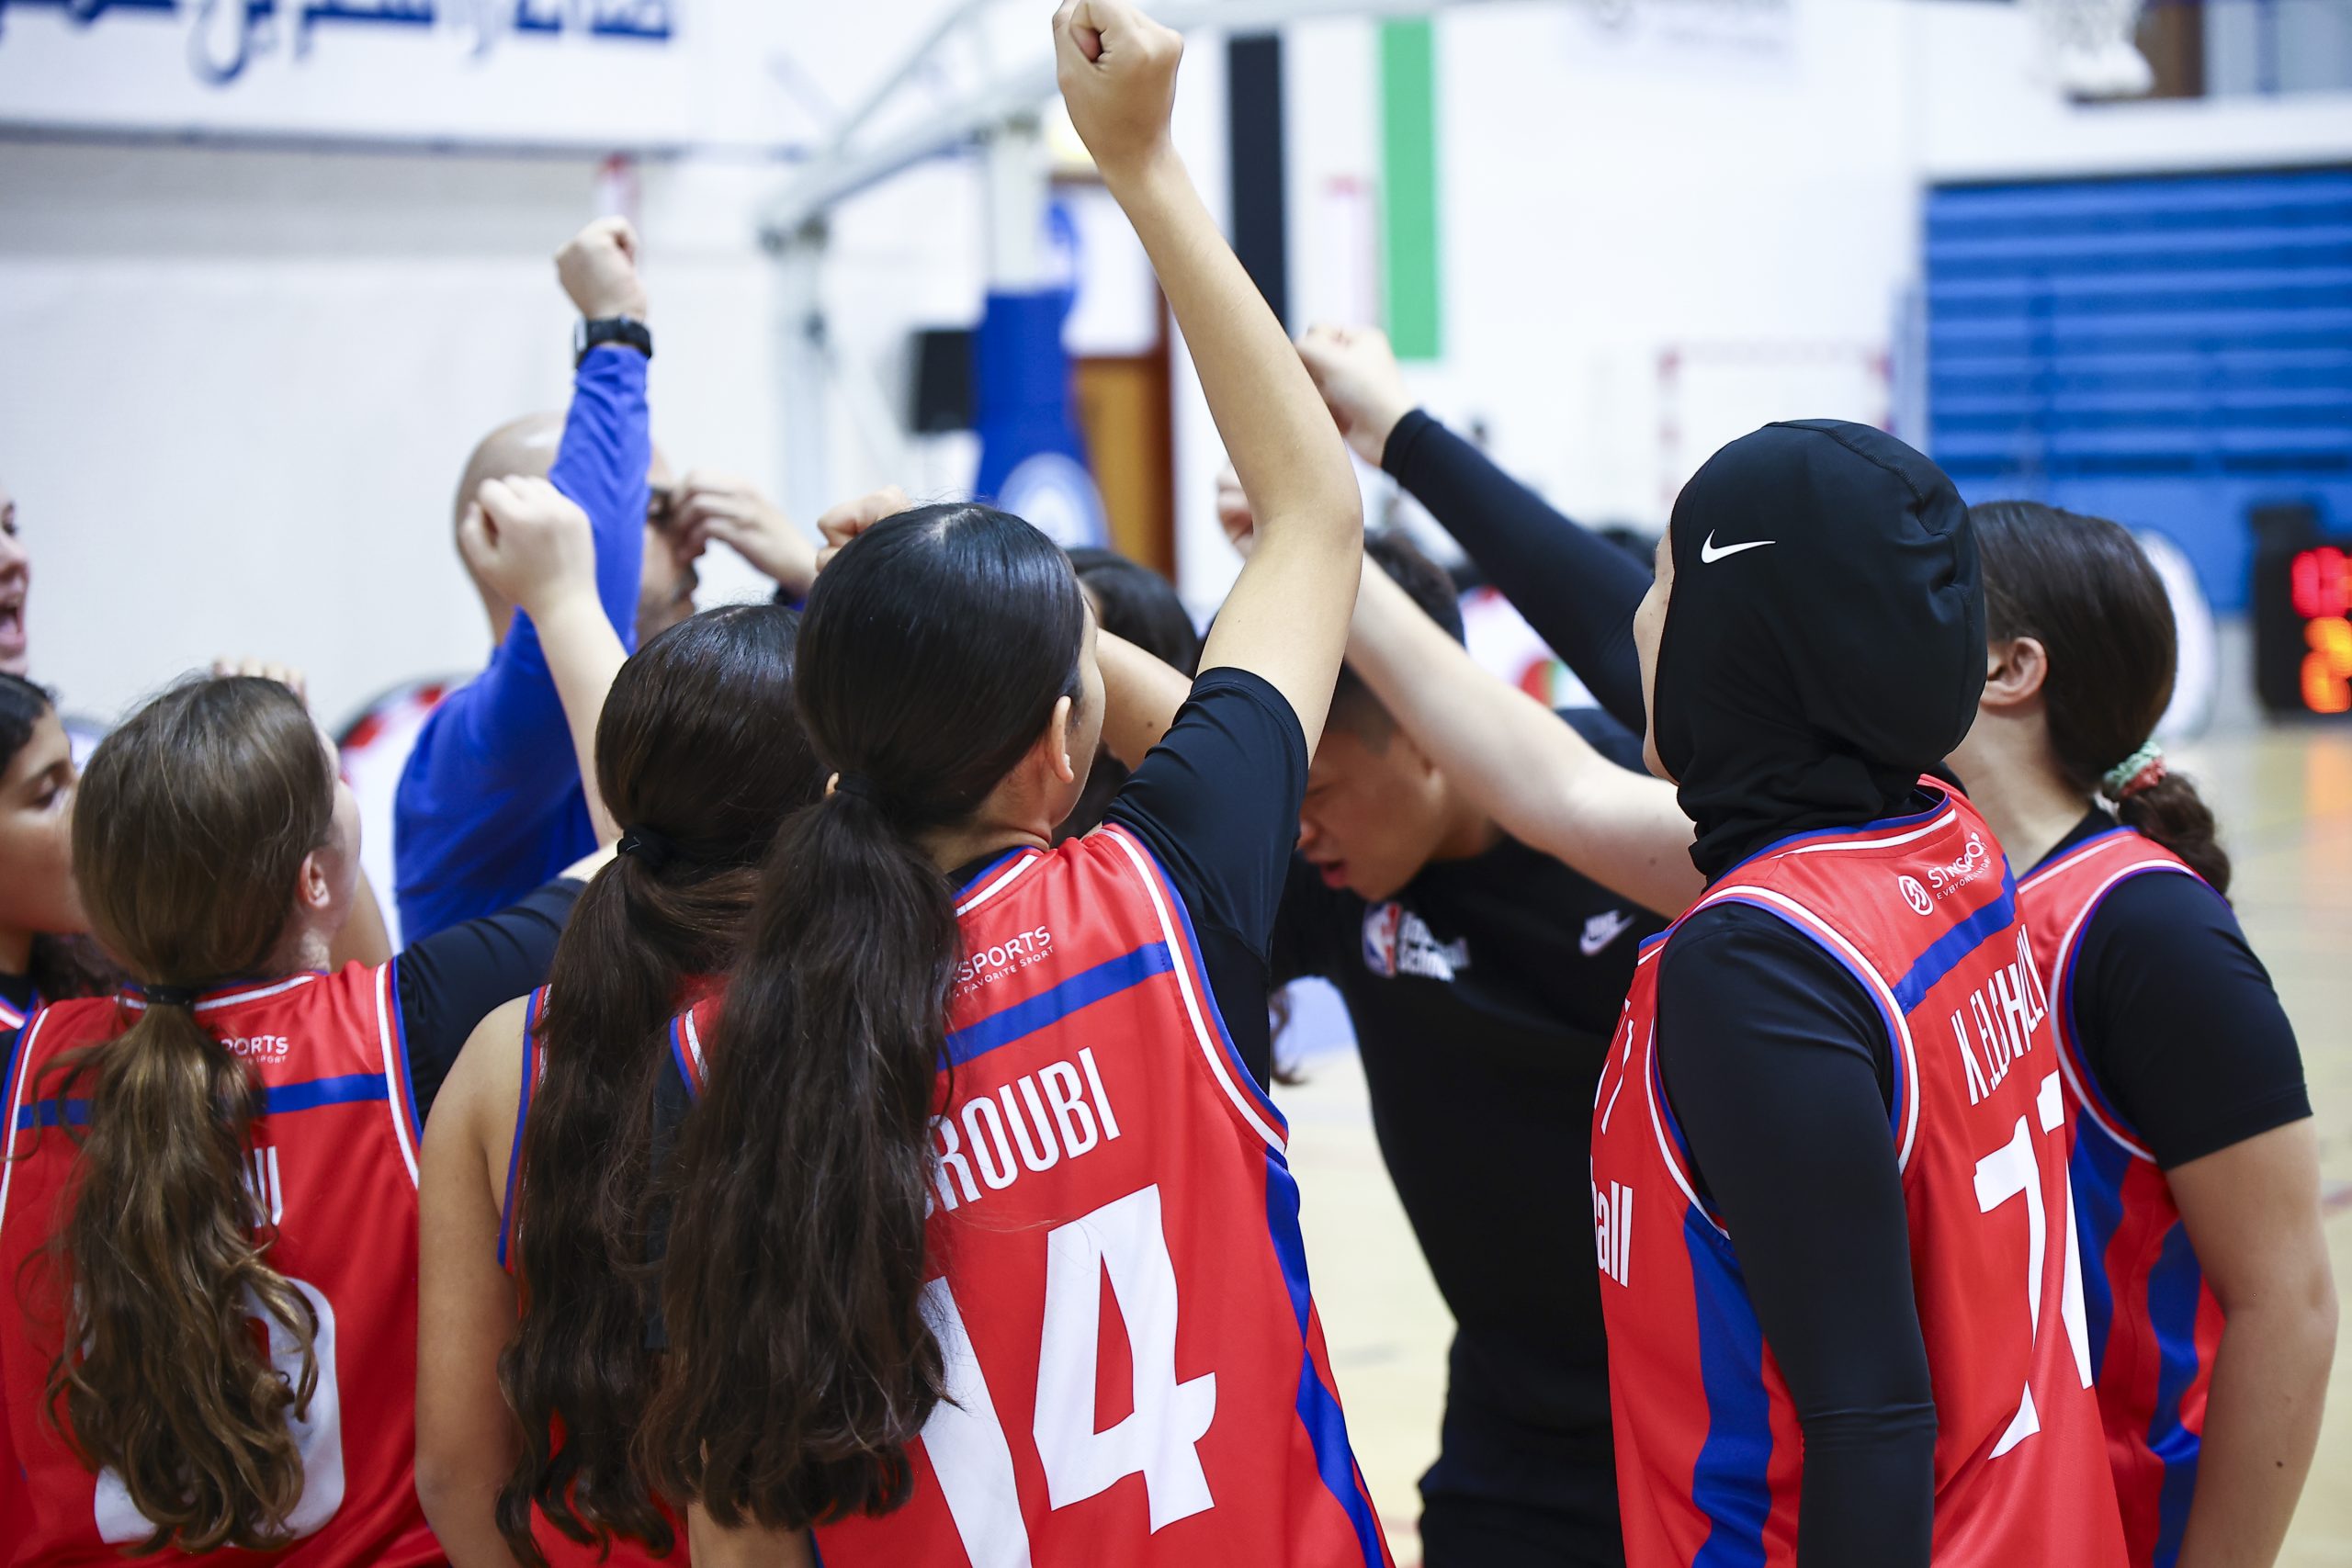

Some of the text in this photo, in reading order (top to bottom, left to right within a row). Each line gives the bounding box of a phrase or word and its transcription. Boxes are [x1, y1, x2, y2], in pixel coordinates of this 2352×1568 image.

[956, 926, 1051, 983] SPORTS
[1019, 945, 1054, 967] SPORT
[925, 1046, 1122, 1220] ROUBI
[919, 1182, 1217, 1568] 14
